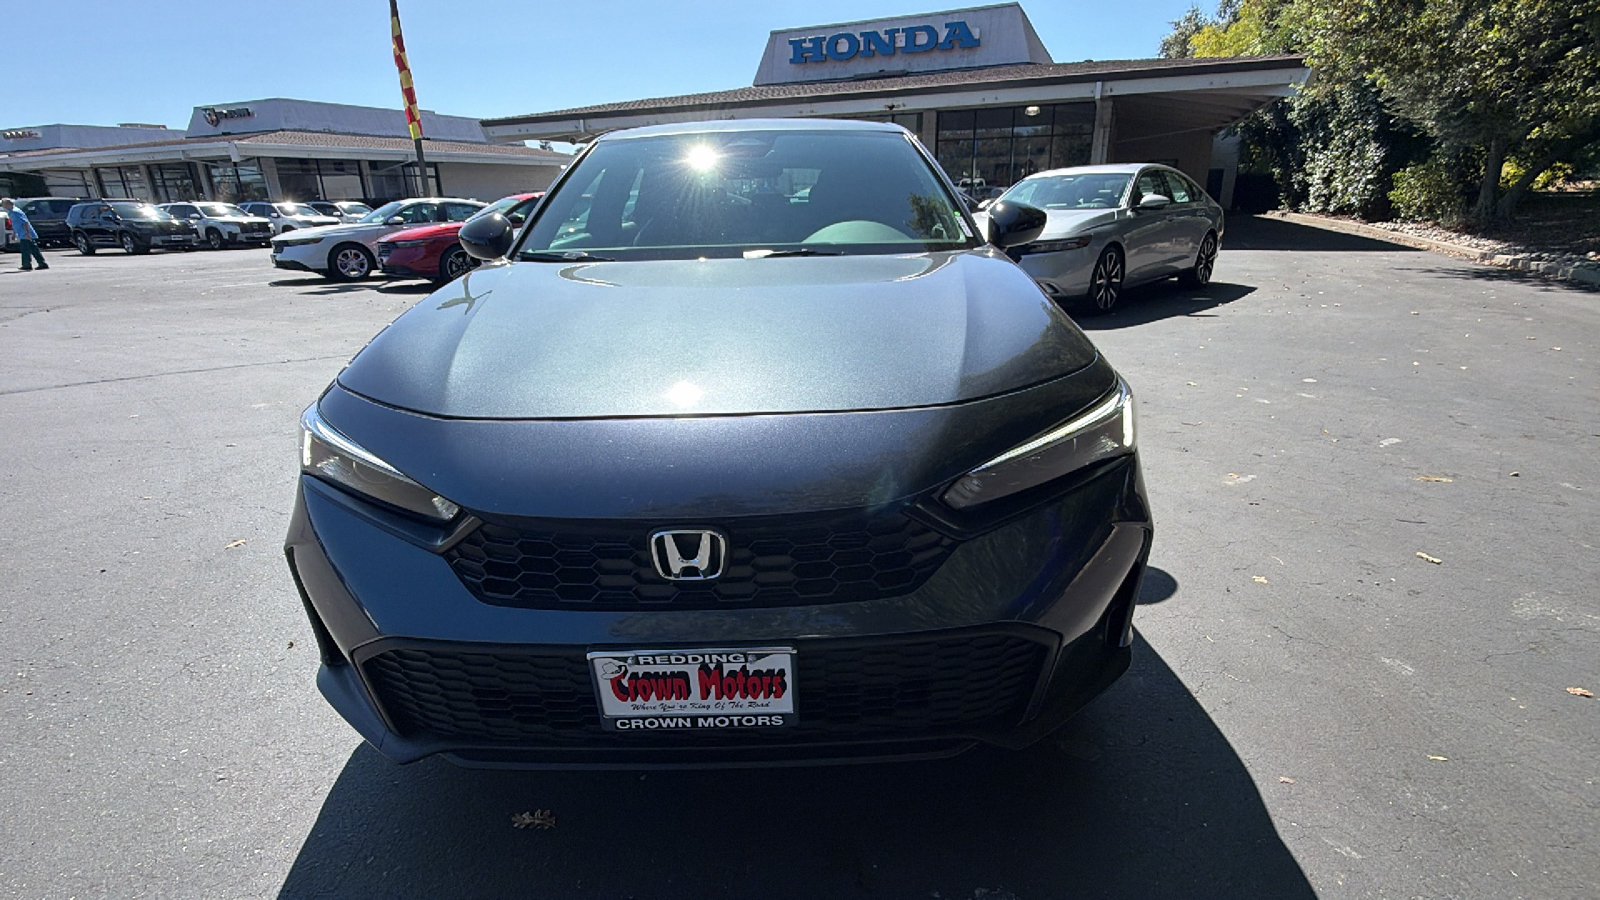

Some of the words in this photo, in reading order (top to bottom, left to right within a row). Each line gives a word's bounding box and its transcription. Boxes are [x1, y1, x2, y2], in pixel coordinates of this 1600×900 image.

[788, 20, 981, 65] HONDA
[638, 653, 746, 665] REDDING
[609, 664, 692, 702] Crown
[697, 663, 788, 701] Motors
[630, 703, 658, 711] Where
[689, 702, 711, 711] King
[714, 701, 726, 711] Of
[728, 701, 744, 709] The
[746, 701, 771, 709] Road
[616, 717, 692, 729] CROWN
[697, 715, 784, 728] MOTORS
